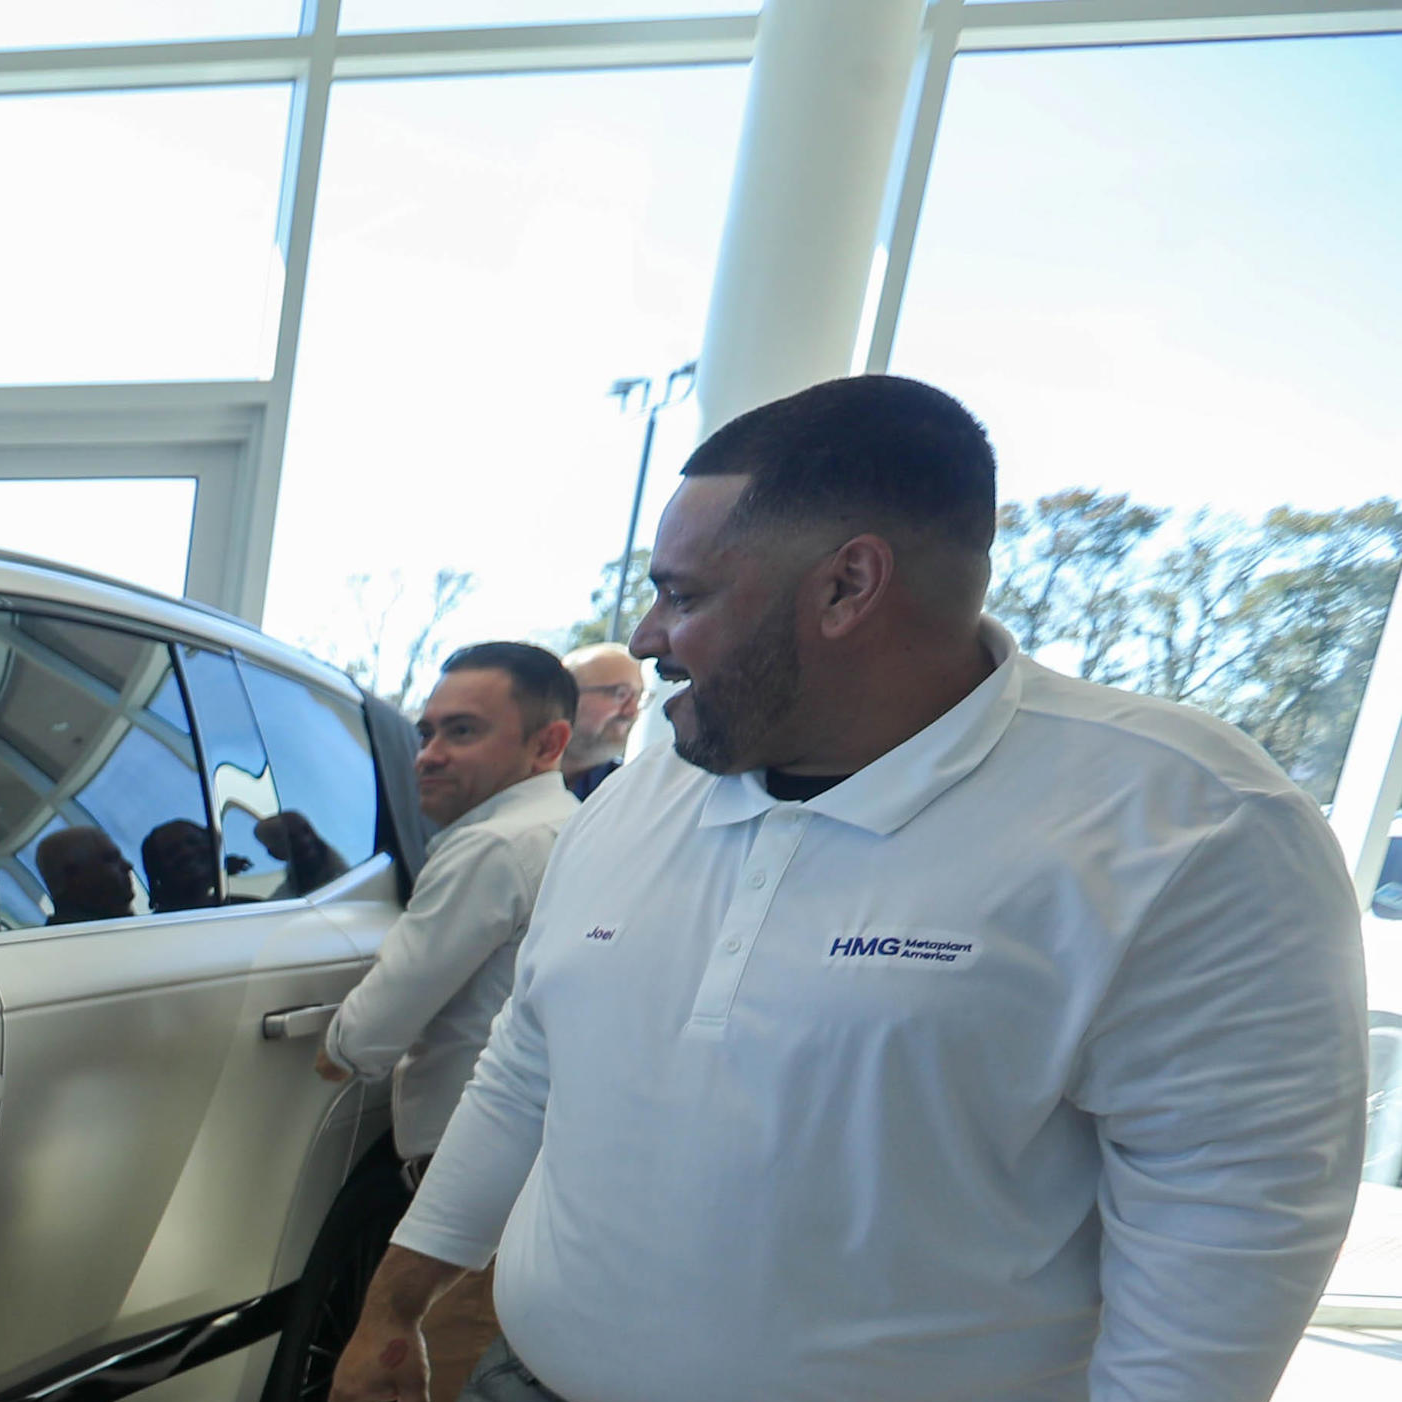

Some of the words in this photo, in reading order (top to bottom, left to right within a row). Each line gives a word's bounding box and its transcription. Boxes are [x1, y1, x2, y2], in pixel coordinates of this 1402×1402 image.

[586, 925, 616, 941] Joel
[829, 937, 902, 957] HMG
[904, 938, 973, 953] Metaplant
[900, 950, 957, 963] America
